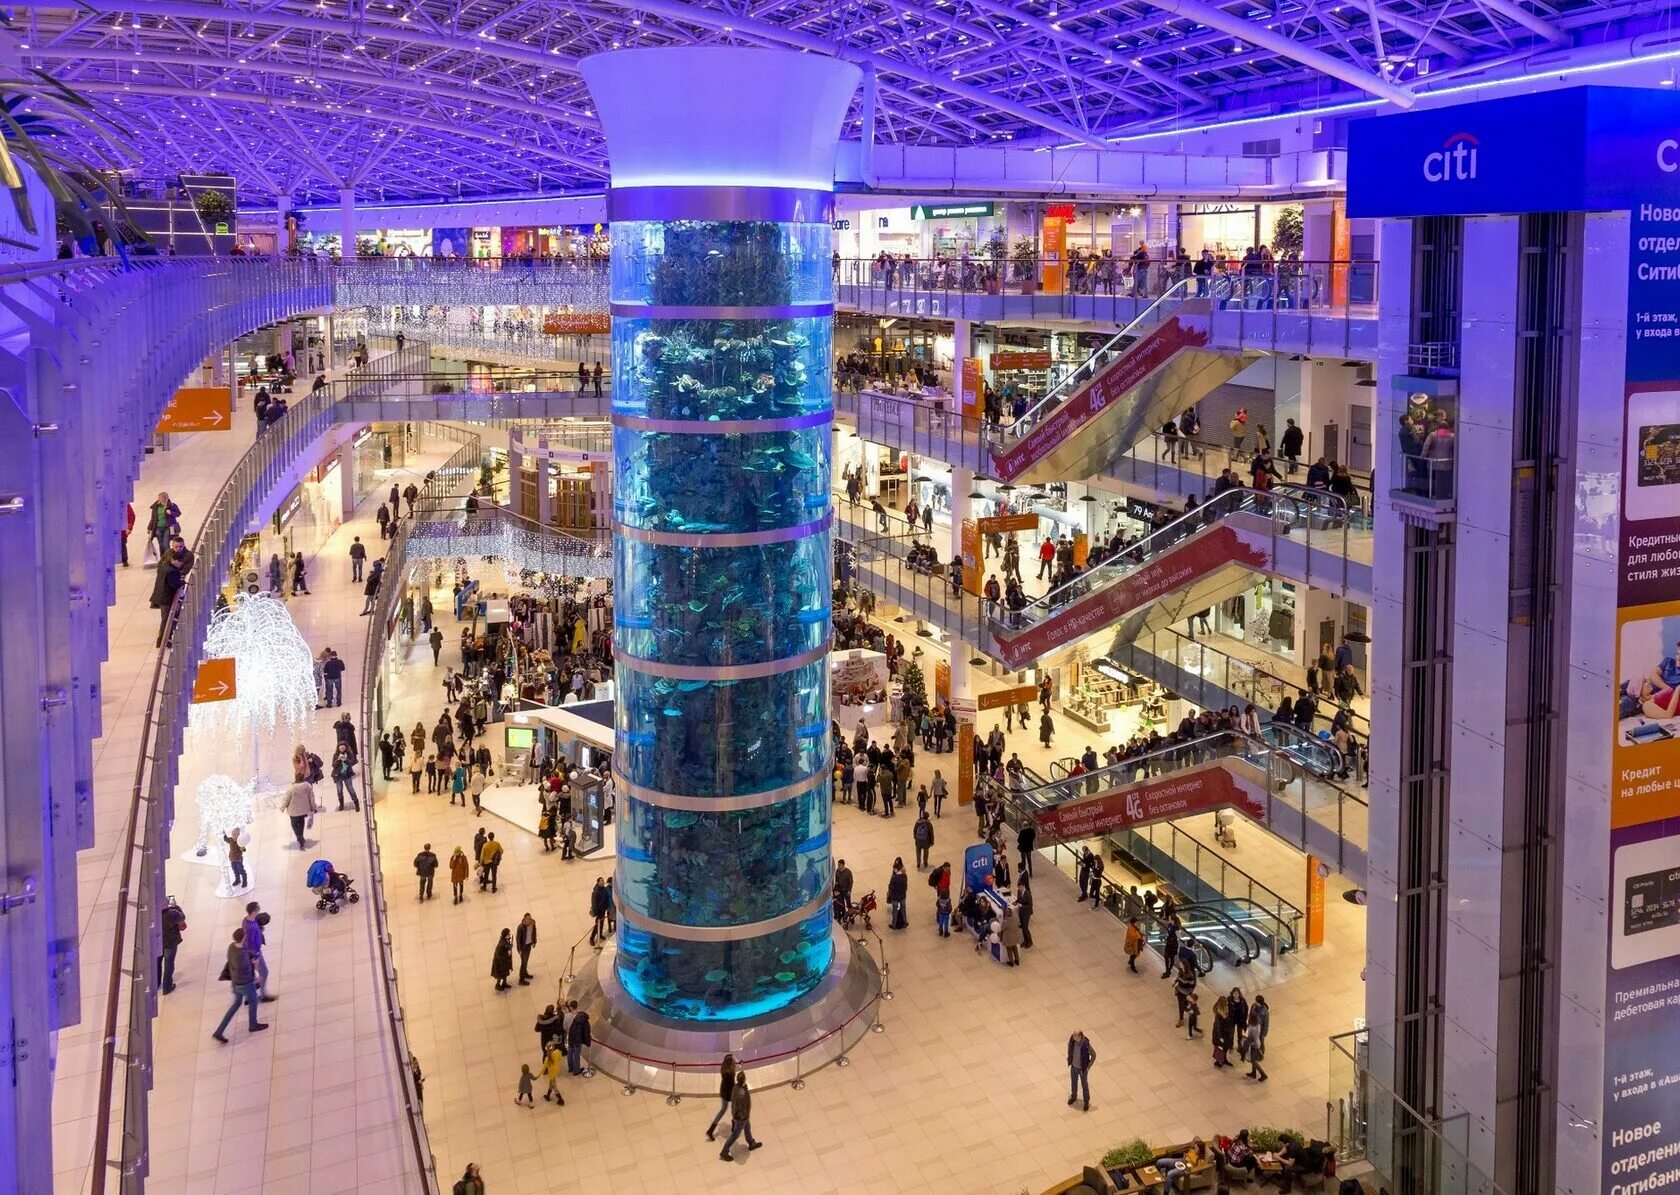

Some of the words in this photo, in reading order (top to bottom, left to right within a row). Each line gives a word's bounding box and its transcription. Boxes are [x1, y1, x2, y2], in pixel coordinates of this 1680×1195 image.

[1423, 141, 1477, 182] citi
[1652, 313, 1677, 323] этаж,
[1644, 328, 1672, 338] входа
[1629, 533, 1680, 549] Кредитны
[1627, 554, 1648, 567] для
[1650, 548, 1680, 562] любо
[1627, 569, 1658, 581] стиля
[1621, 766, 1661, 782] Кредит
[1145, 784, 1176, 800] Скоростной
[1177, 780, 1204, 792] интернет
[1621, 788, 1634, 798] на
[1635, 780, 1672, 795] любые
[1126, 794, 1144, 820] 4G
[1159, 800, 1188, 813] остановок
[1095, 814, 1123, 829] интернет
[972, 856, 988, 868] citi
[1614, 998, 1665, 1022] дебетовая
[1614, 1074, 1627, 1086] 1-й
[1629, 1068, 1654, 1081] этаж,
[1613, 1091, 1619, 1102] у
[1621, 1083, 1649, 1098] входа
[1650, 1081, 1657, 1089] в
[1612, 1121, 1662, 1148] Новое
